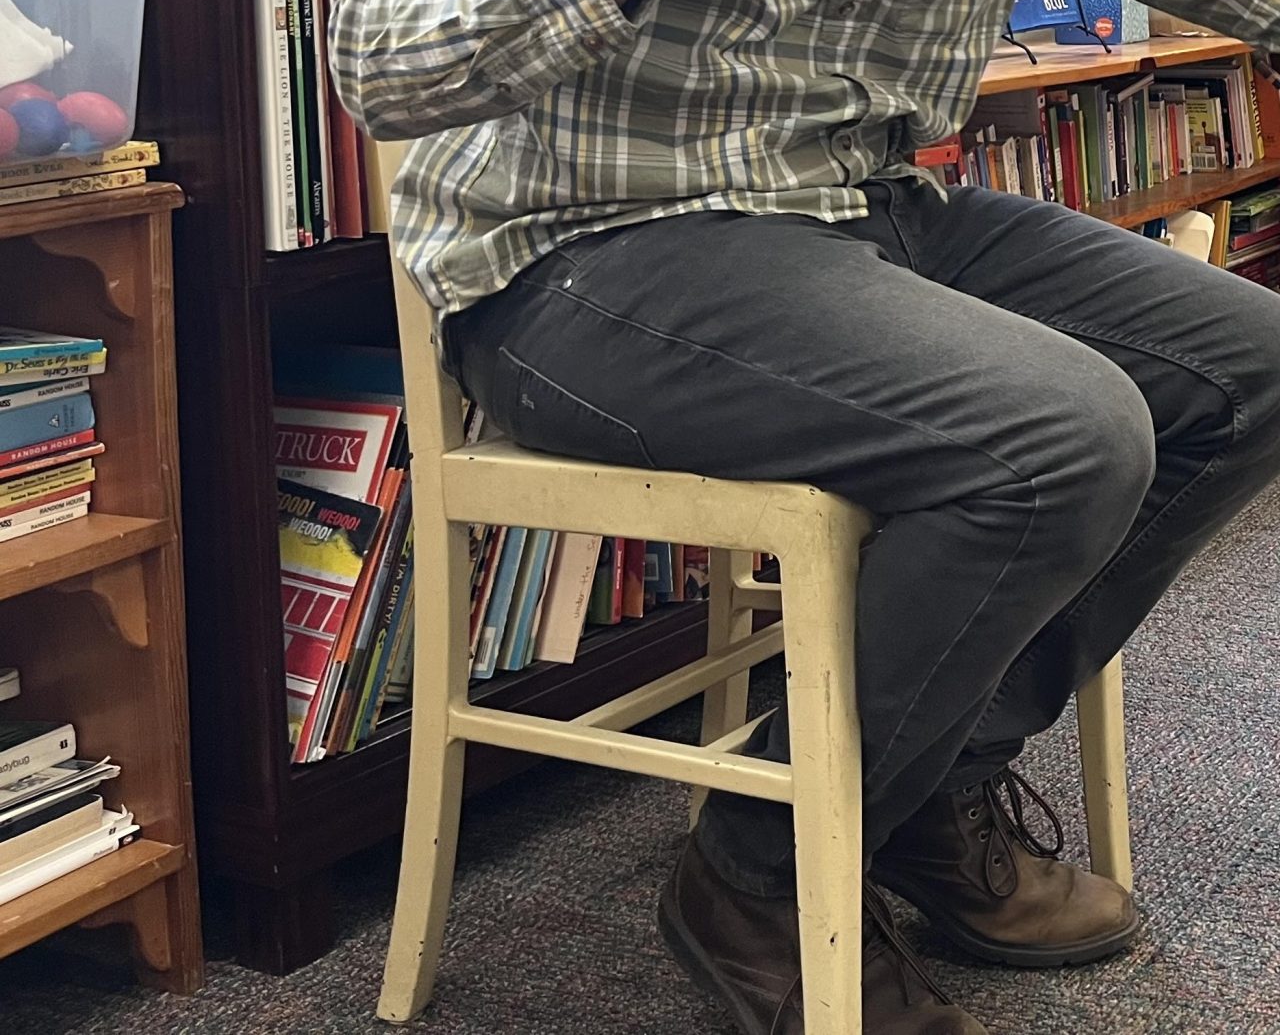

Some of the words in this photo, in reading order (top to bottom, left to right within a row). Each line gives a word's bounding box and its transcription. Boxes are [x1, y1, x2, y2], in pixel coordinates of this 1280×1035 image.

[279, 35, 288, 61] THE
[280, 67, 289, 99] LION
[283, 119, 291, 147] THE
[284, 153, 294, 198] MOUSE
[313, 180, 323, 216] Abrams
[21, 358, 46, 370] Seuss
[43, 367, 68, 377] Carle
[71, 365, 88, 373] Eric
[38, 386, 63, 396] RANDOM
[11, 445, 48, 460] RANDOM
[50, 437, 77, 450] HOUSE
[275, 431, 361, 465] TRUCK
[39, 503, 65, 515] RANDOM
[66, 496, 85, 506] HOUSE
[30, 519, 55, 530] RANDOM
[55, 513, 74, 523] HOUSE
[399, 563, 407, 580] I'M
[385, 583, 401, 624] DIRTY!
